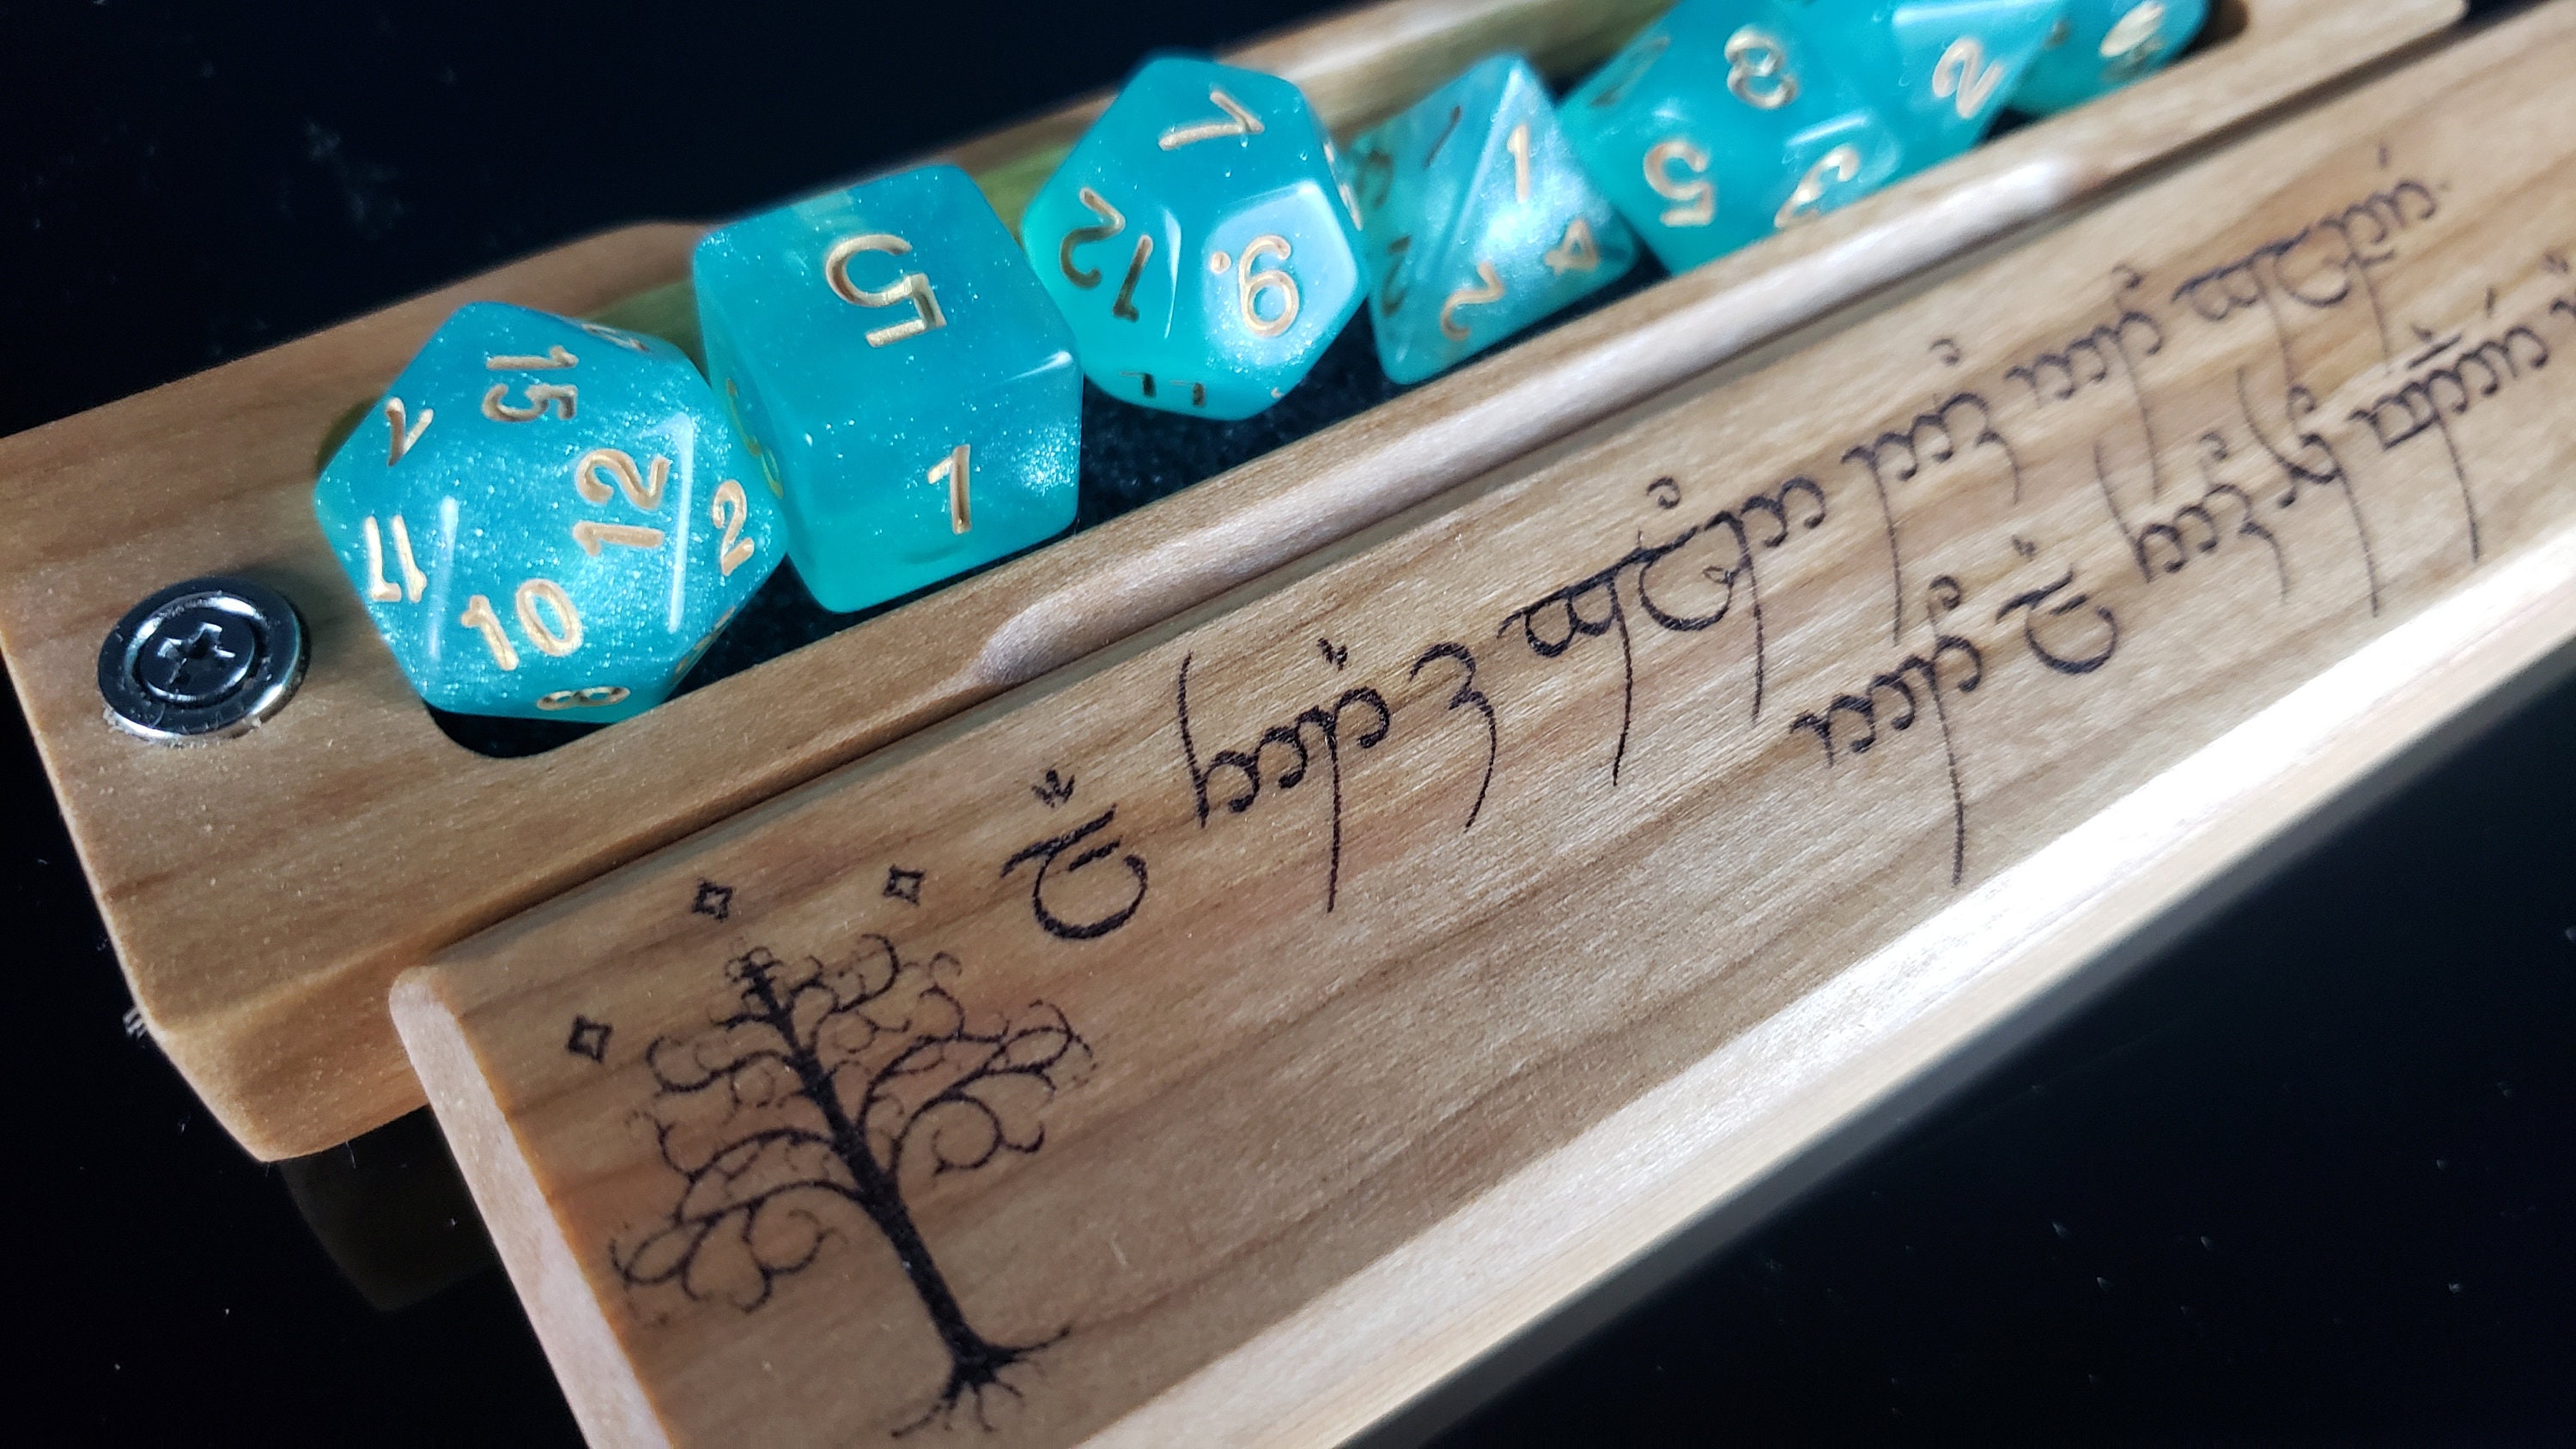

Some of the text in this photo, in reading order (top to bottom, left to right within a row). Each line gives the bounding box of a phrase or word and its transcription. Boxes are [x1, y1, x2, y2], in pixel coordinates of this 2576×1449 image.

[1931, 36, 2008, 119] 2
[1506, 123, 1532, 203] 1
[1643, 138, 1715, 228] 5
[825, 233, 947, 349] 5
[1059, 186, 1153, 323] 12
[1543, 217, 1599, 276] 4
[1439, 260, 1505, 342] 2
[481, 344, 580, 423] 15
[573, 448, 671, 556] 12
[710, 479, 755, 577] 2
[927, 444, 973, 535] 1
[460, 578, 584, 672] 10
[536, 685, 631, 712] 8
